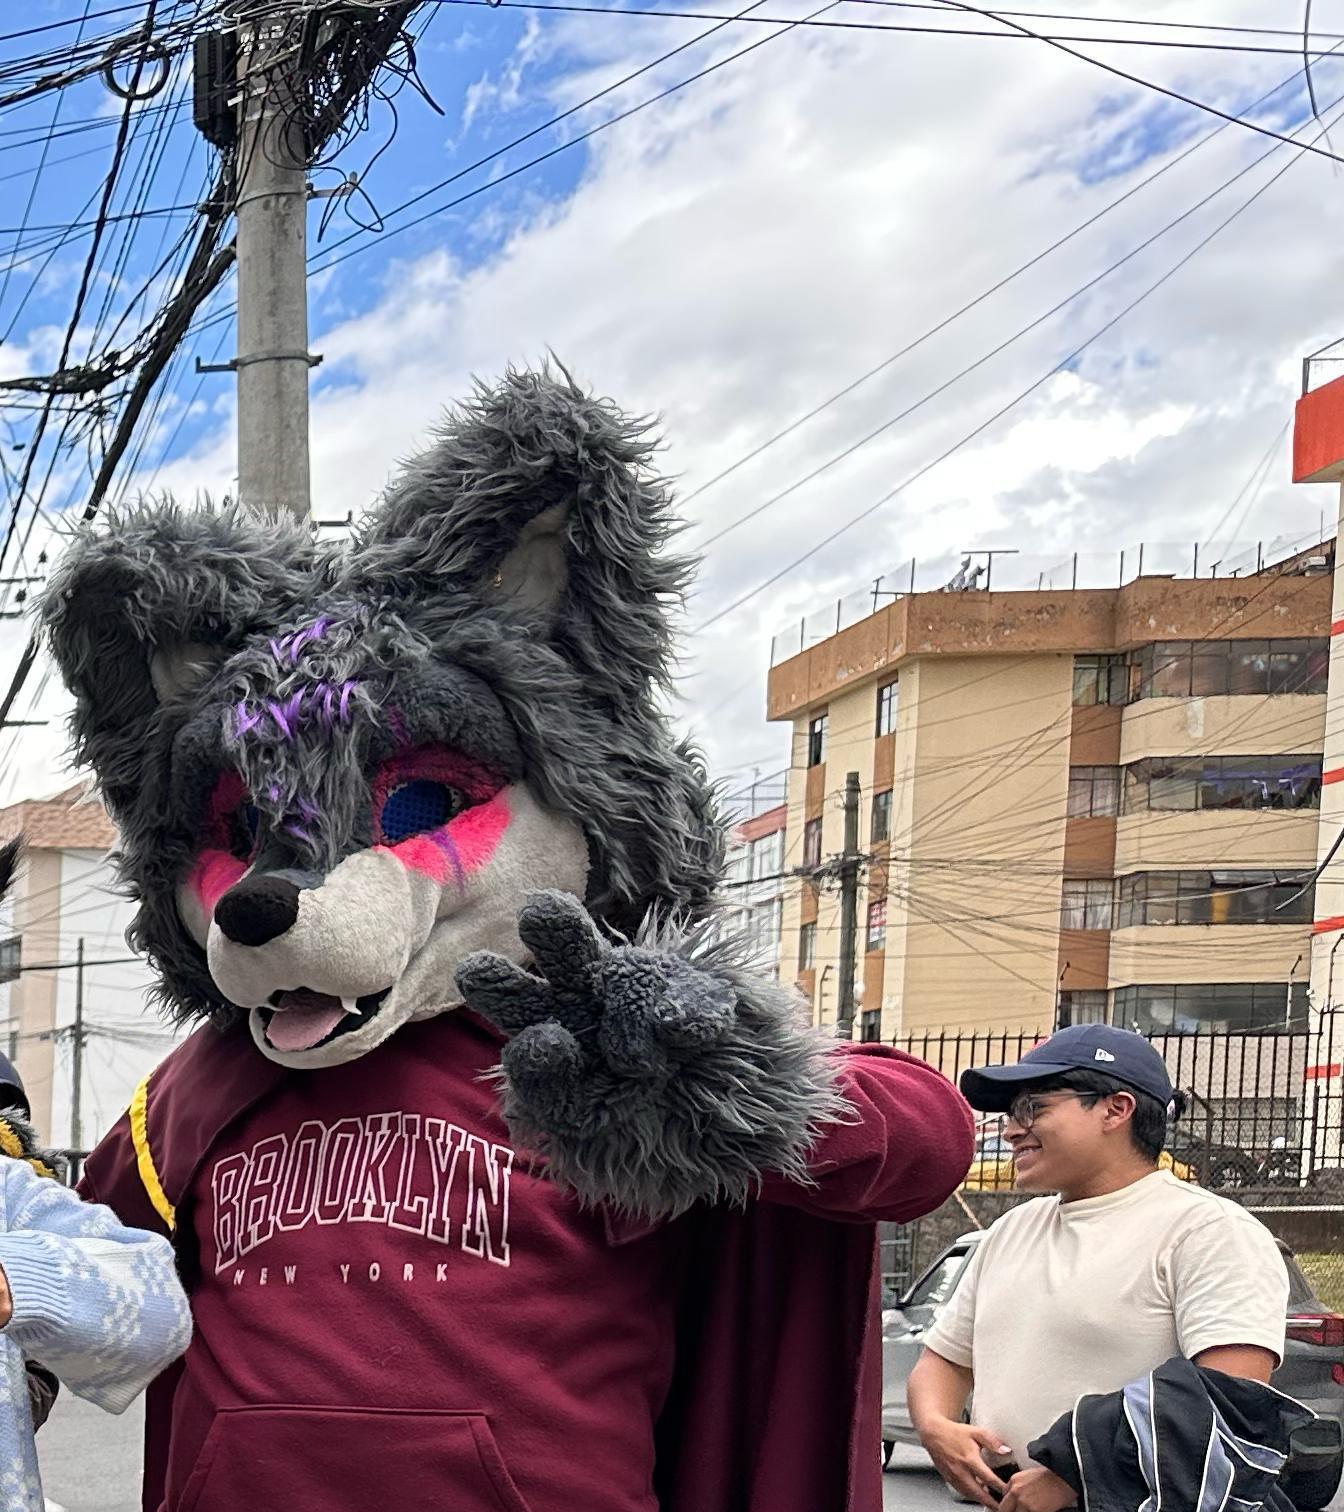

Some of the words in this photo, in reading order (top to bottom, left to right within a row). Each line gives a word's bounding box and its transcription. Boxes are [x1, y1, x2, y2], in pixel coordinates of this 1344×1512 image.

[212, 1111, 515, 1275] BROOKLYN
[233, 1265, 297, 1286] NEW
[340, 1262, 448, 1285] YORK
